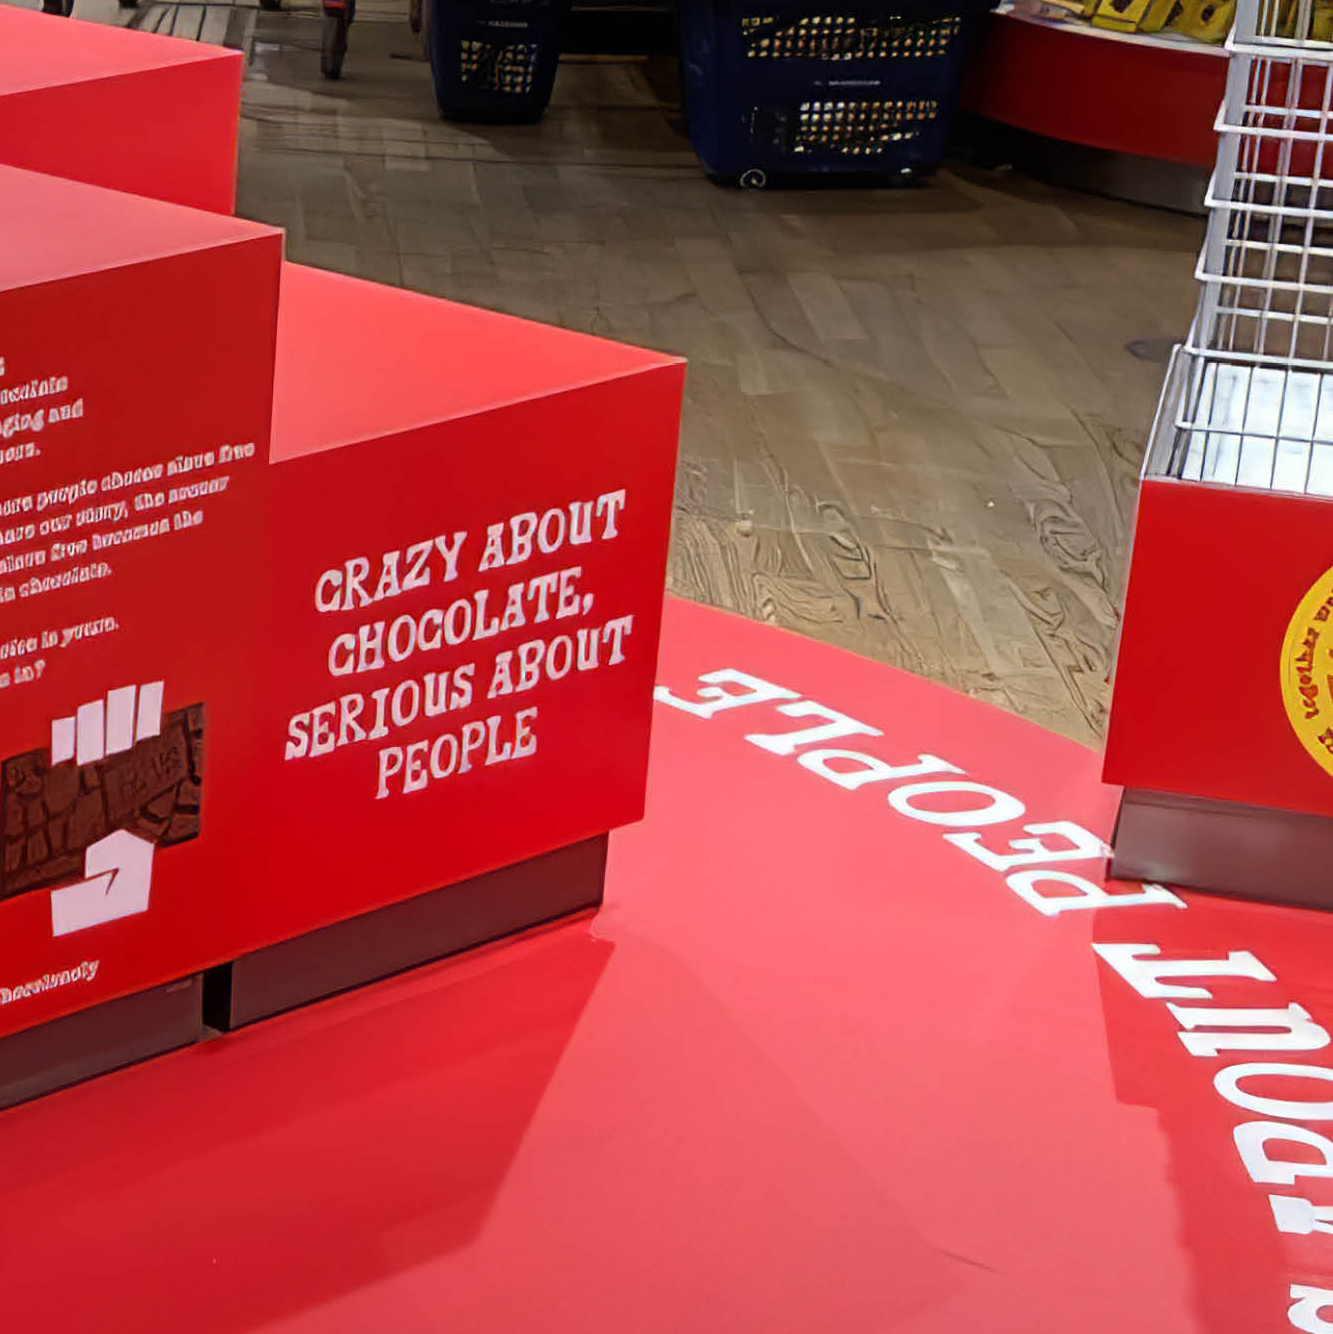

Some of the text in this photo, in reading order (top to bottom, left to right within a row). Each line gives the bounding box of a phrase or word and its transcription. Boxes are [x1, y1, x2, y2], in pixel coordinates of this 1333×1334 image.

[316, 490, 625, 612] CRAZY ABOUT
[329, 567, 593, 676] CHOCOLATE,
[285, 615, 632, 760] SERIOUS ABOUT
[376, 707, 537, 798] PEOPLE
